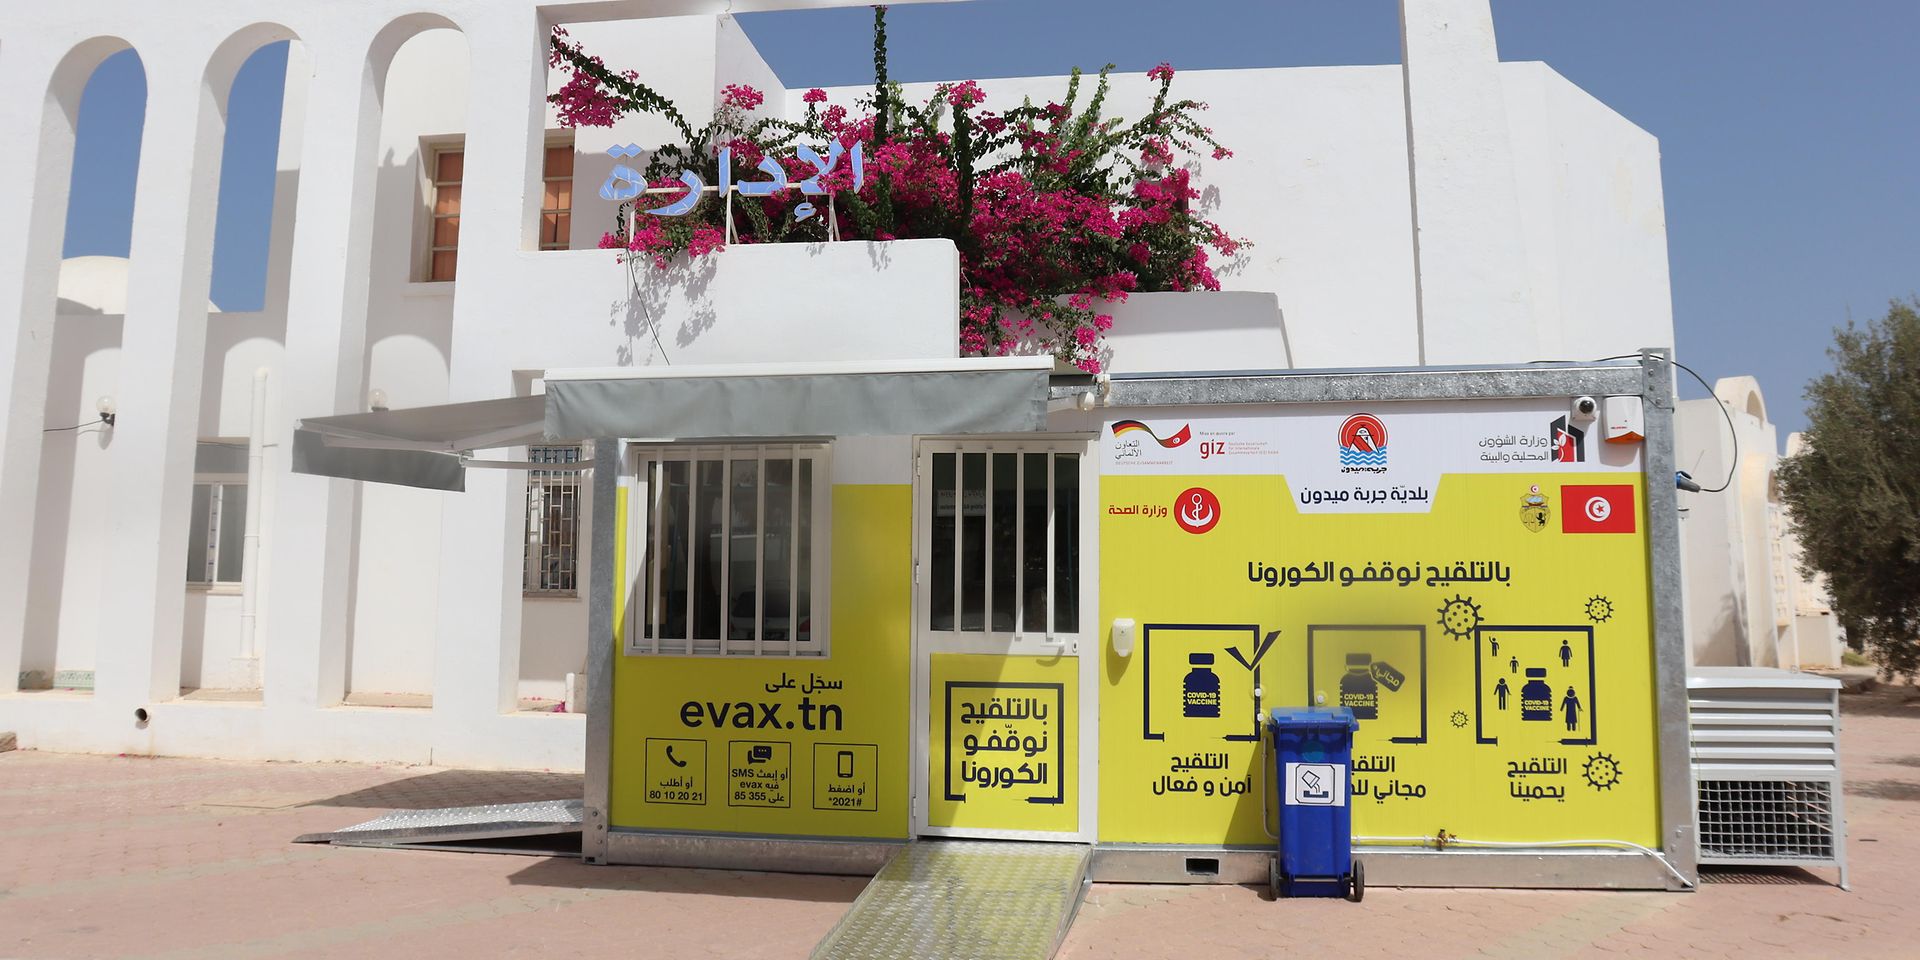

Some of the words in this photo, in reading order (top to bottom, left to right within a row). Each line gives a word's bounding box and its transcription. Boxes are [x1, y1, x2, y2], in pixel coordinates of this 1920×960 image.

[600, 138, 864, 222] الإدارة
[1115, 439, 1140, 450] التعاون
[1200, 439, 1225, 459] giz
[1479, 435, 1516, 448] الشؤون
[1519, 436, 1548, 448] وزارة
[1115, 449, 1142, 460] الألماني
[1512, 451, 1549, 463] المحلية
[1300, 487, 1349, 504] ميدون
[1354, 487, 1387, 504] جربة
[1108, 504, 1139, 515] الصحة
[1142, 505, 1168, 518] وزارة
[1248, 561, 1334, 587] الكورونا
[1339, 561, 1420, 587] نوقفو
[1426, 561, 1510, 587] بالتلقيح
[765, 672, 796, 692] على
[680, 697, 842, 730] evax.tn
[961, 698, 1048, 726] بالتلقيح
[1170, 753, 1228, 772] التلقيح
[1508, 758, 1566, 778] التلقيح
[732, 768, 754, 778] SMS
[780, 768, 788, 780] أو
[962, 760, 1048, 788] الكورونا
[685, 776, 693, 789] أو
[766, 783, 779, 792] فيه
[858, 782, 866, 795] أو
[1152, 775, 1198, 796] فعال
[1203, 780, 1214, 796] و
[650, 790, 660, 798] 80
[664, 791, 675, 800] 10
[678, 792, 689, 800] 20
[692, 792, 702, 800] 21
[734, 792, 746, 800] 85
[748, 792, 766, 800] 355
[768, 793, 784, 803] على
[1374, 780, 1426, 804] مجاني
[1510, 781, 1564, 802] يحمينا
